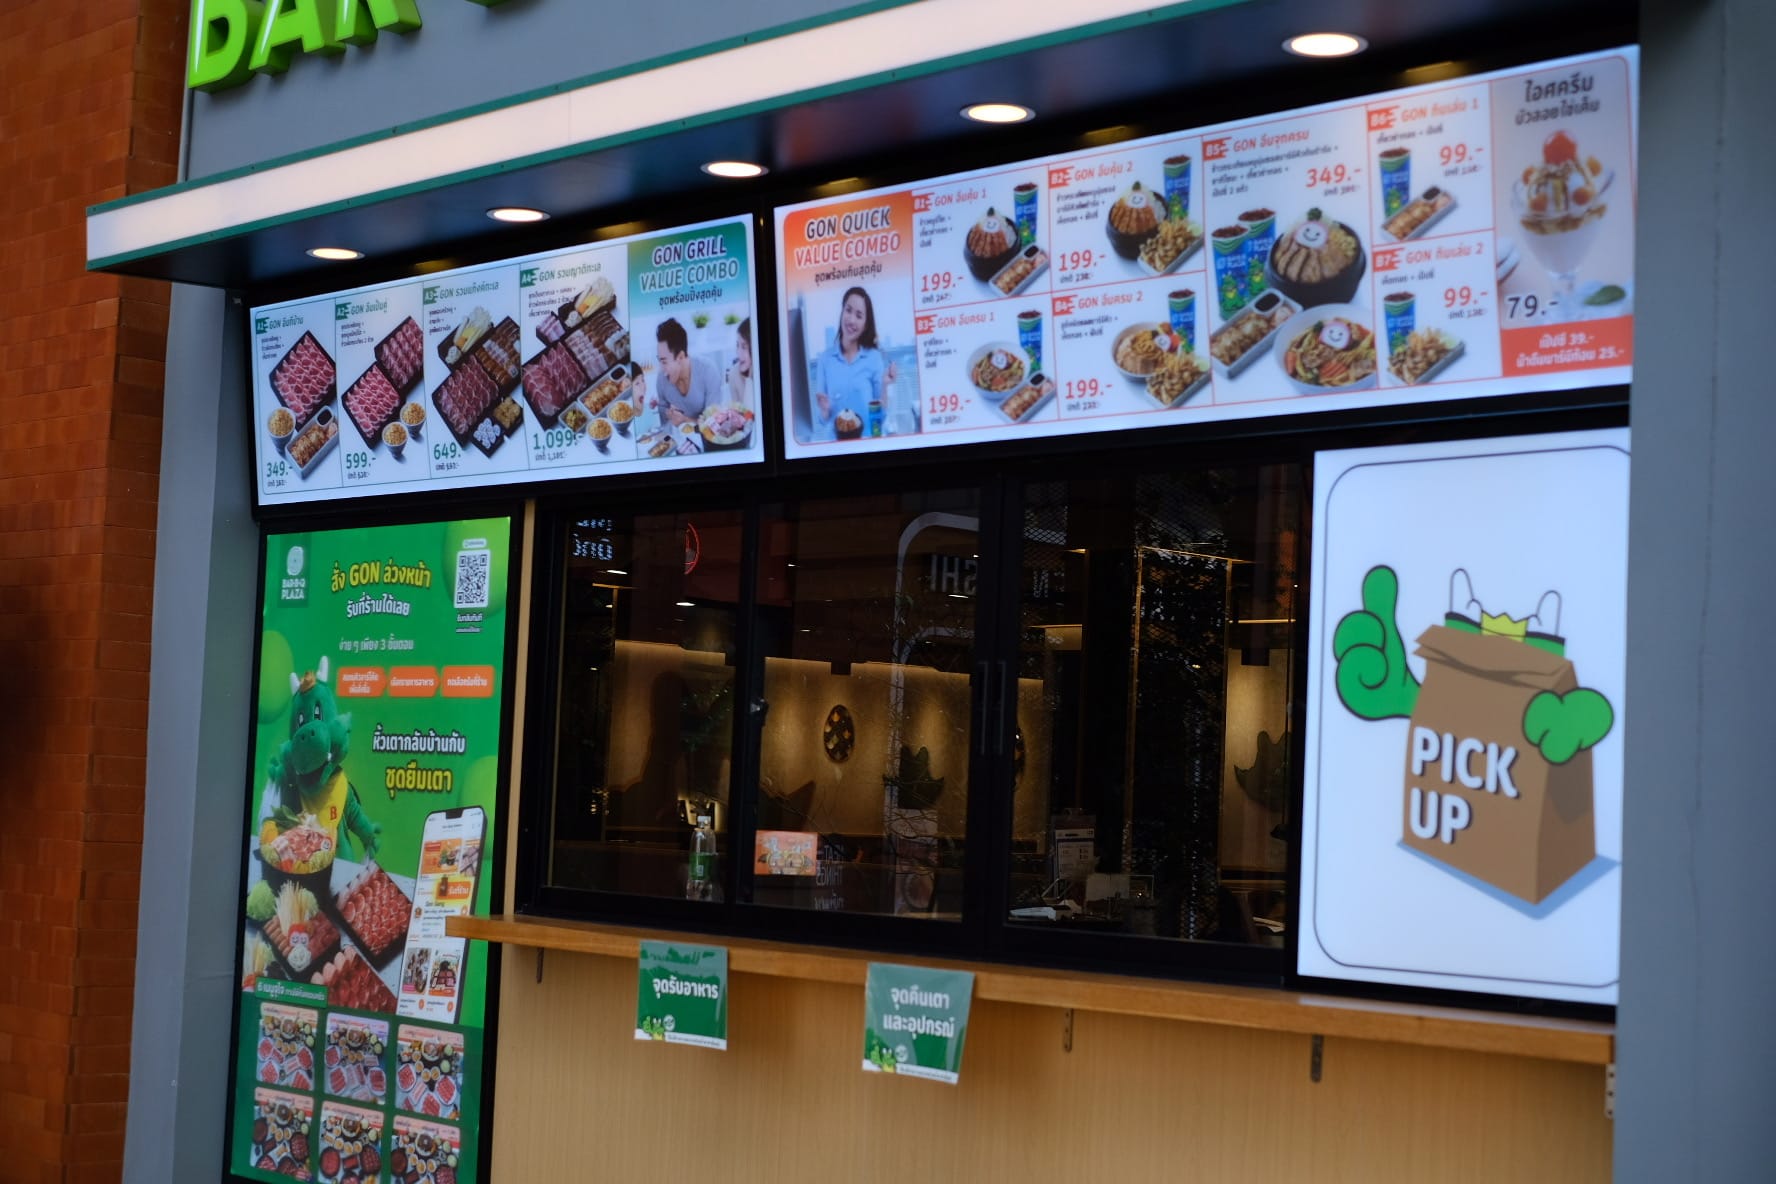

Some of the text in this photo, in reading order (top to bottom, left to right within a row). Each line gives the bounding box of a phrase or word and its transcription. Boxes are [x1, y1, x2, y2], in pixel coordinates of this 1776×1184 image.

[1233, 137, 1256, 152] GON
[1440, 143, 1484, 166] 99.-
[1075, 168, 1095, 181] GON
[1127, 160, 1133, 172] 2
[1305, 163, 1361, 188] 349.-
[935, 194, 953, 207] GON
[807, 207, 890, 239] GON QUICK
[654, 237, 727, 266] GON GRILL
[796, 233, 900, 267] VALUE COMBO
[1059, 249, 1106, 272] 199.-
[1406, 250, 1432, 264] GON
[1475, 242, 1484, 254] 2
[539, 270, 555, 282] GON
[641, 260, 738, 291] VALUE COMBO
[921, 271, 963, 293] 199.-
[439, 289, 454, 300] GON
[1078, 296, 1098, 309] GON
[1136, 290, 1143, 302] 2
[1444, 286, 1488, 308] 99.-
[350, 304, 364, 315] GON
[1507, 294, 1558, 319] 79.-
[937, 316, 956, 329] GON
[1065, 378, 1112, 399] 199.-
[929, 393, 971, 414] 199.-
[266, 461, 293, 478] 349.-
[346, 451, 376, 469] 599.-
[331, 558, 431, 592] สั่ง GON ล่วงหน้า
[346, 591, 411, 618] รับที่ร้านได้เลย
[380, 638, 386, 651] 3
[373, 724, 465, 753] หิ้วเตากลับบ้านกับ
[1411, 726, 1520, 799] PICK
[386, 761, 452, 798] ชุดยืมเตา
[1409, 787, 1472, 844] UP
[653, 974, 719, 999] จุดรับอาหาร
[891, 984, 950, 1011] จุดคืนเตา
[882, 1014, 955, 1040] และอุปกรณ์
